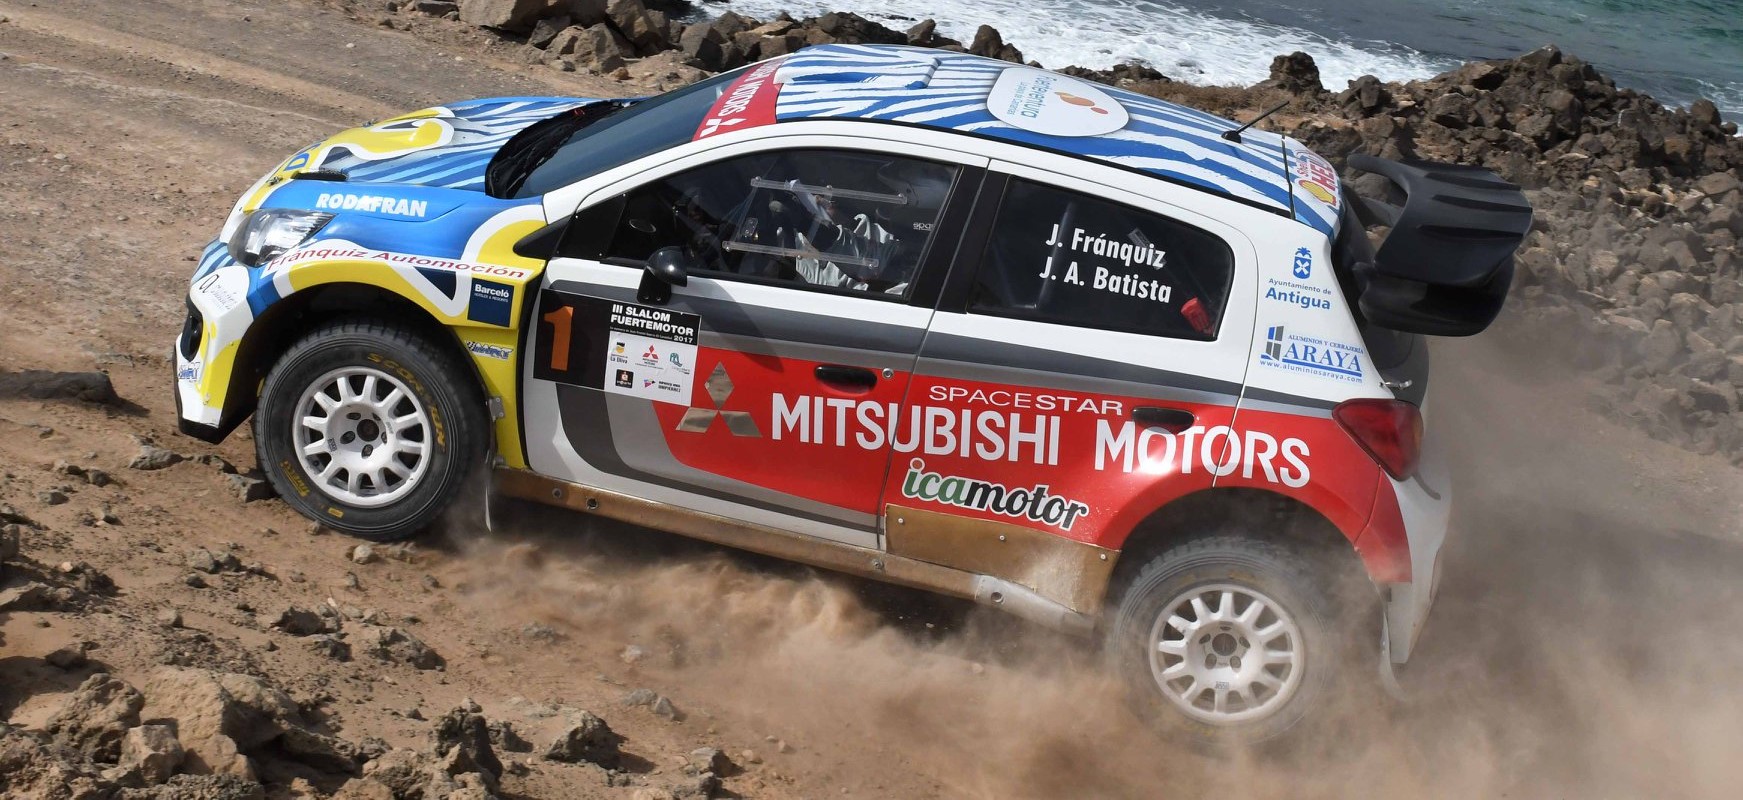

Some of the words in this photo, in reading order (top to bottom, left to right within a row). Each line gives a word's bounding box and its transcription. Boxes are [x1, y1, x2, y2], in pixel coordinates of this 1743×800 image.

[315, 193, 427, 218] RODAFRAN
[1045, 224, 1063, 248] J.
[1071, 228, 1166, 268] Fránquiz
[268, 247, 365, 271] Fránquiz
[370, 251, 525, 279] Automoción
[474, 283, 510, 298] Barceló
[1039, 256, 1057, 281] J.
[1064, 261, 1085, 286] A.
[1093, 266, 1172, 303] Batista
[1268, 278, 1321, 293] Ayuntamiento
[1265, 287, 1331, 310] Antigua
[610, 314, 694, 337] FUERTEMOTOR
[612, 304, 624, 314] III
[625, 306, 671, 323] SLALOM
[544, 306, 574, 371] 1
[673, 335, 693, 344] 2017
[1288, 334, 1323, 345] ALUMINIOS
[1283, 342, 1362, 372] ARAYA
[1260, 360, 1363, 383] www.aluminiosaraya.com
[772, 392, 1061, 466] MITSUBISHI
[1094, 418, 1311, 488] MOTORS
[902, 458, 1089, 531] icamotor
